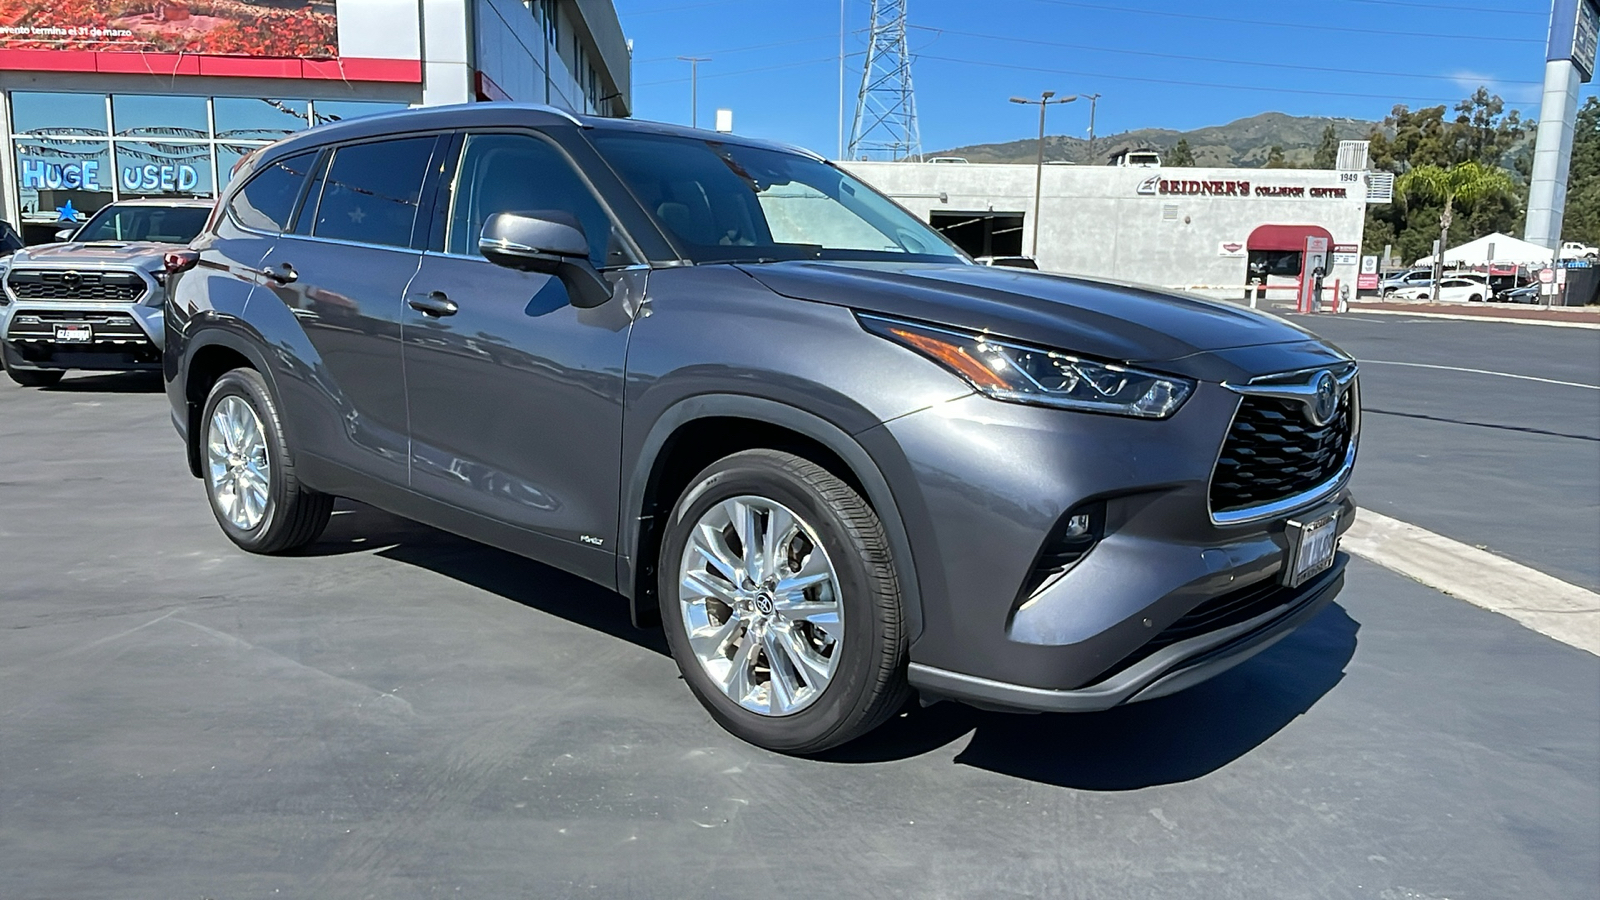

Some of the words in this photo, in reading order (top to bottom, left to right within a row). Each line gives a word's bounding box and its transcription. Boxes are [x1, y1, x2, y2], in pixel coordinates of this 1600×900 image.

[31, 26, 66, 35] termina
[68, 27, 76, 35] el
[90, 28, 100, 36] de
[22, 159, 99, 190] HUGE
[123, 165, 198, 189] USED
[1340, 173, 1358, 182] 1949
[1159, 180, 1249, 195] SEIDNER'S
[1255, 186, 1304, 197] COLLISION
[1310, 187, 1346, 198] CENTER
